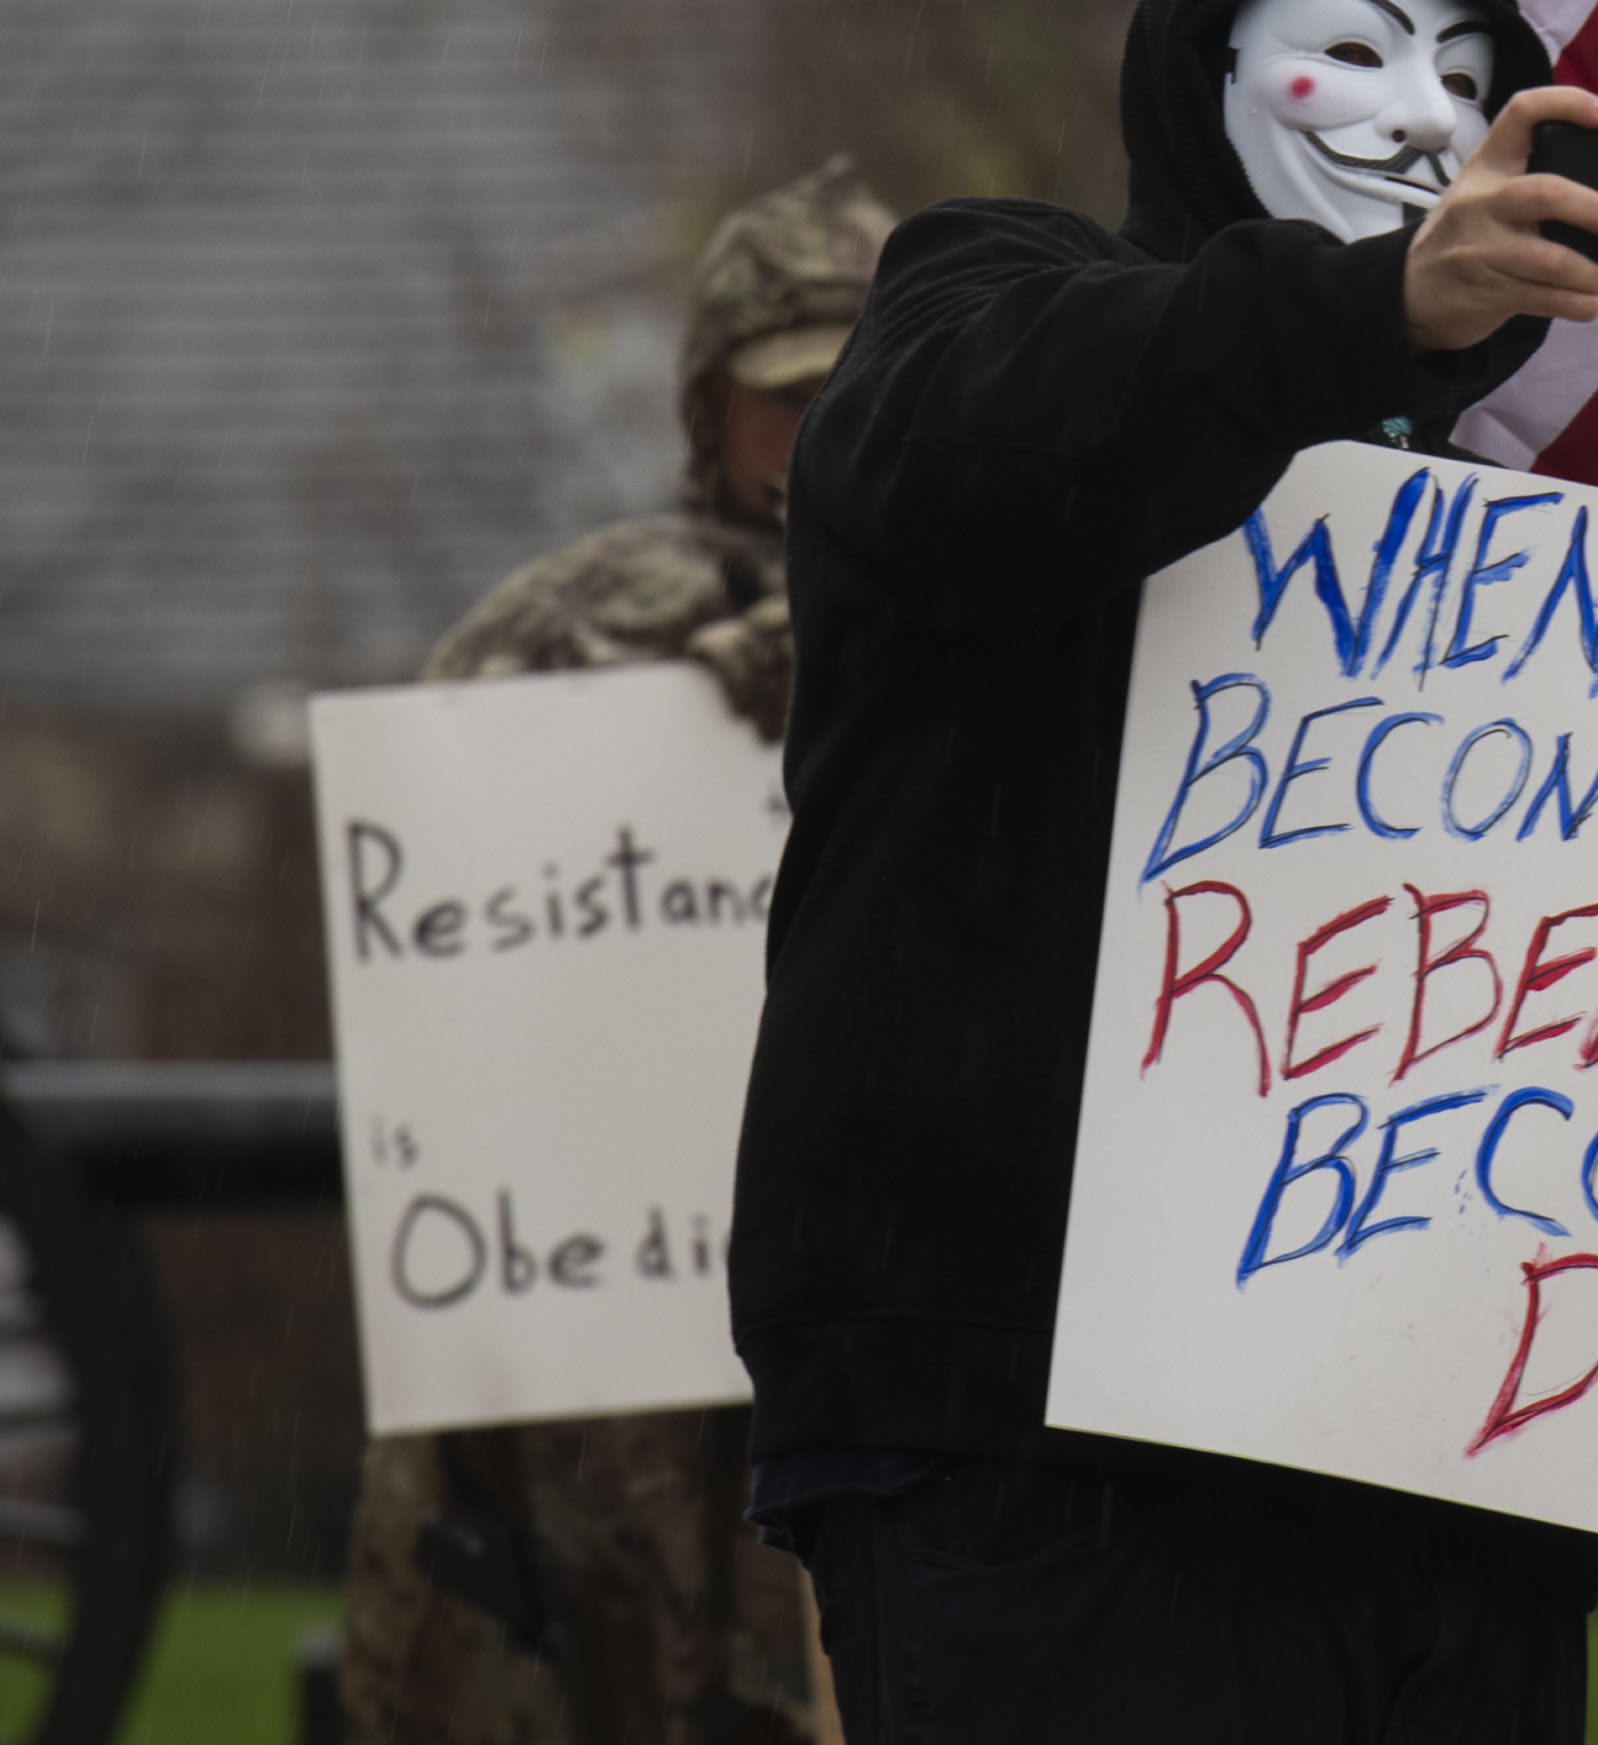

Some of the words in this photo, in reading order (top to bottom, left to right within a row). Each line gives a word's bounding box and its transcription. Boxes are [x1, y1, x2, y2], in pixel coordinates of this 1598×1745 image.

[346, 818, 774, 964] Resistanc
[370, 1118, 419, 1170] is
[391, 1188, 732, 1309] Obedi
